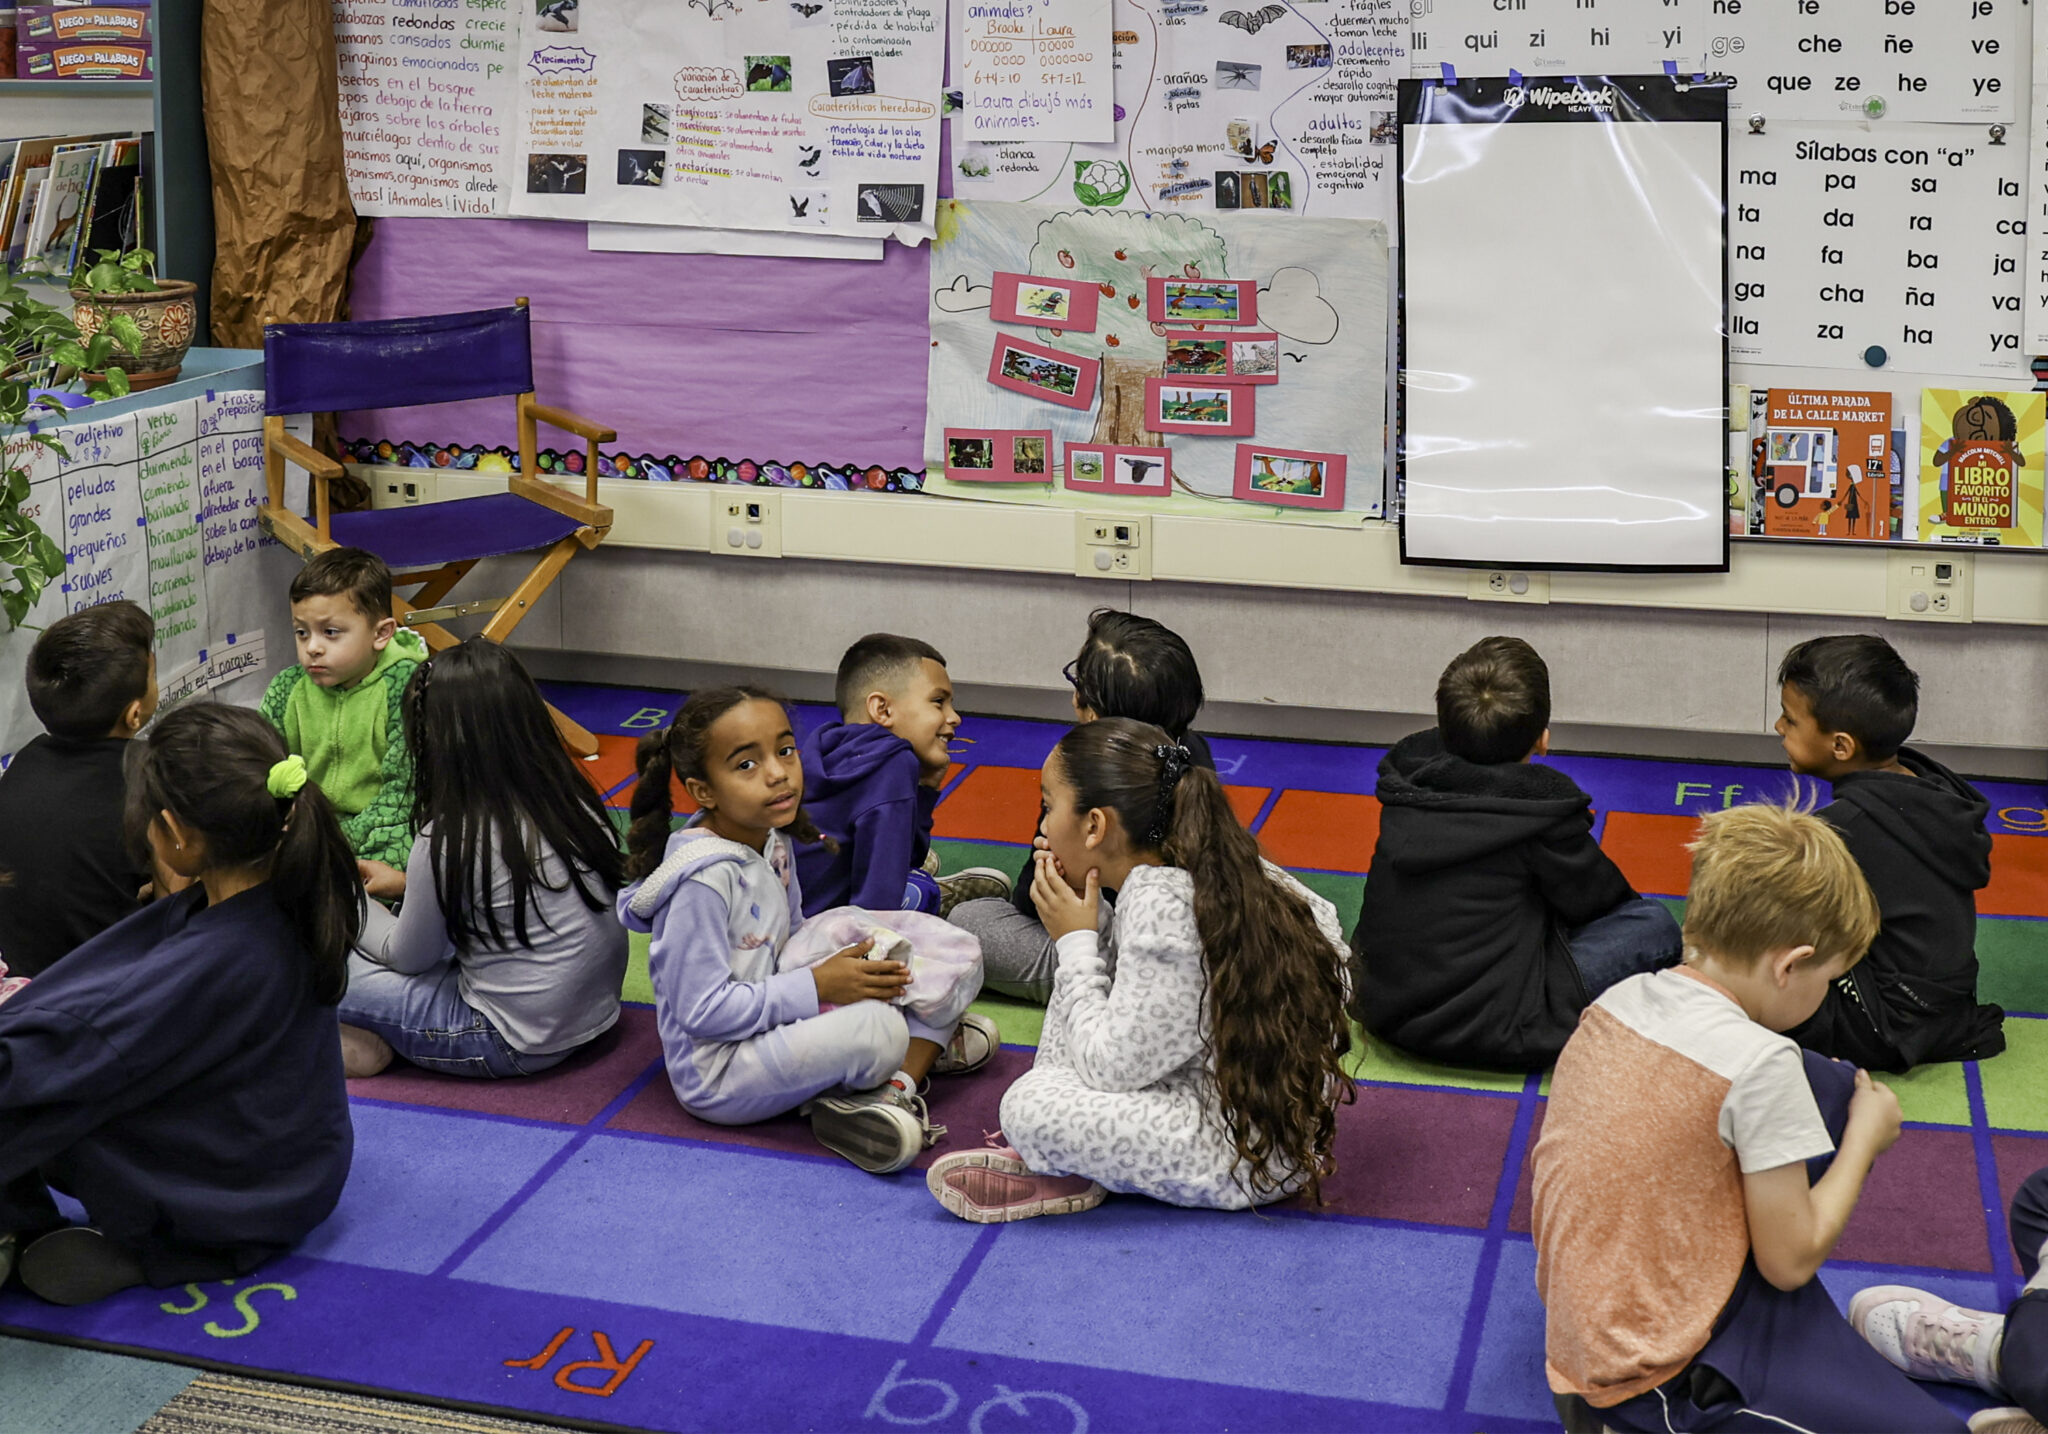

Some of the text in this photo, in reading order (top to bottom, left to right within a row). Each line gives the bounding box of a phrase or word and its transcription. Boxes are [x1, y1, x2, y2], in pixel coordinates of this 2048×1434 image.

[893, 8, 903, 16] de
[907, 7, 930, 20] plaga
[968, 1, 1033, 19] animales?
[1350, 0, 1391, 16] frágiles
[1884, 0, 1915, 15] be
[59, 17, 84, 29] JUEGO
[94, 15, 138, 28] PALABRAS
[392, 14, 455, 30] redondas
[837, 20, 894, 32] pérdida de
[987, 18, 1074, 35] Brooke Laura
[1166, 17, 1186, 26] alas
[1330, 11, 1409, 26] duermen mucho
[840, 35, 848, 43] la
[1335, 26, 1397, 37] toman leche
[1412, 26, 1682, 52] lli qui zi hi yi
[389, 34, 451, 48] cansados
[1339, 41, 1405, 57] adolecentes
[1712, 36, 1745, 58] ge
[1798, 35, 1842, 53] che
[1884, 35, 1914, 54] ñe
[1971, 39, 2000, 54] ve
[59, 54, 85, 66] JUEGO
[94, 53, 138, 66] PALABRAS
[339, 52, 479, 72] pingüinos emocionados
[534, 53, 585, 64] Crecimiento
[1337, 58, 1390, 66] crecimiento
[1164, 72, 1208, 85] arañas
[1338, 67, 1372, 80] rápido
[387, 77, 475, 97] en el bosque
[1323, 78, 1363, 90] desarollo
[1767, 73, 2001, 96] que ze he ye
[532, 88, 555, 98] leche
[1314, 94, 1343, 104] mayor
[1530, 86, 1614, 108] Wipebook
[376, 91, 493, 116] debajo de la tierra
[881, 100, 931, 113] heredadas
[974, 90, 1092, 114] Laura dibujó más
[1176, 99, 1200, 114] patas
[386, 113, 500, 136] sobre los árboles
[974, 110, 1040, 129] animales.
[1309, 112, 1361, 130] adultos
[342, 127, 499, 155] murciélagos dentro de sus
[1000, 150, 1035, 159] blanca
[1146, 144, 1193, 158] mariposa
[1300, 145, 1337, 159] completo
[1795, 140, 1929, 165] Sílabas con
[56, 161, 78, 178] La
[396, 153, 493, 175] aquí, organismos
[1000, 163, 1039, 173] redonda
[1320, 154, 1383, 169] estabilidad
[398, 174, 459, 190] organismos
[1316, 168, 1378, 181] emocional y
[1740, 169, 2019, 196] ma pa sa la
[56, 182, 66, 192] de
[1318, 178, 1364, 194] cognitiva
[388, 187, 495, 215] ¡Animales! ¡Vida!
[1738, 204, 2027, 235] ta da ra ca
[1736, 244, 2016, 276] na fa ba ja
[1734, 282, 2021, 311] ga cha ña va
[1732, 315, 2019, 352] lla za ha ya
[1788, 392, 1871, 407] ÚLTIMA PARADA
[147, 412, 177, 430] verbo
[1773, 409, 1885, 423] DE LA CALLE MARKET
[75, 425, 123, 447] adjetivo
[201, 438, 224, 458] en el
[1958, 448, 2006, 465] MALCOLM MITCHELL
[140, 448, 192, 479] durmiendo
[202, 457, 225, 477] en el
[1954, 467, 2011, 486] LIBRO
[68, 475, 115, 505] peludos
[144, 472, 190, 501] comiendo
[204, 479, 234, 497] afuera
[1954, 485, 2010, 497] FAVORITO
[1972, 495, 1989, 503] EN EL
[146, 494, 189, 523] bailando
[1953, 502, 2011, 517] MUNDO
[69, 504, 112, 536] grandes
[1964, 516, 1997, 526] ENTERO
[70, 532, 127, 564] pequeños
[72, 567, 113, 591] suaves
[155, 612, 198, 648] gritando
[208, 658, 215, 677] el
